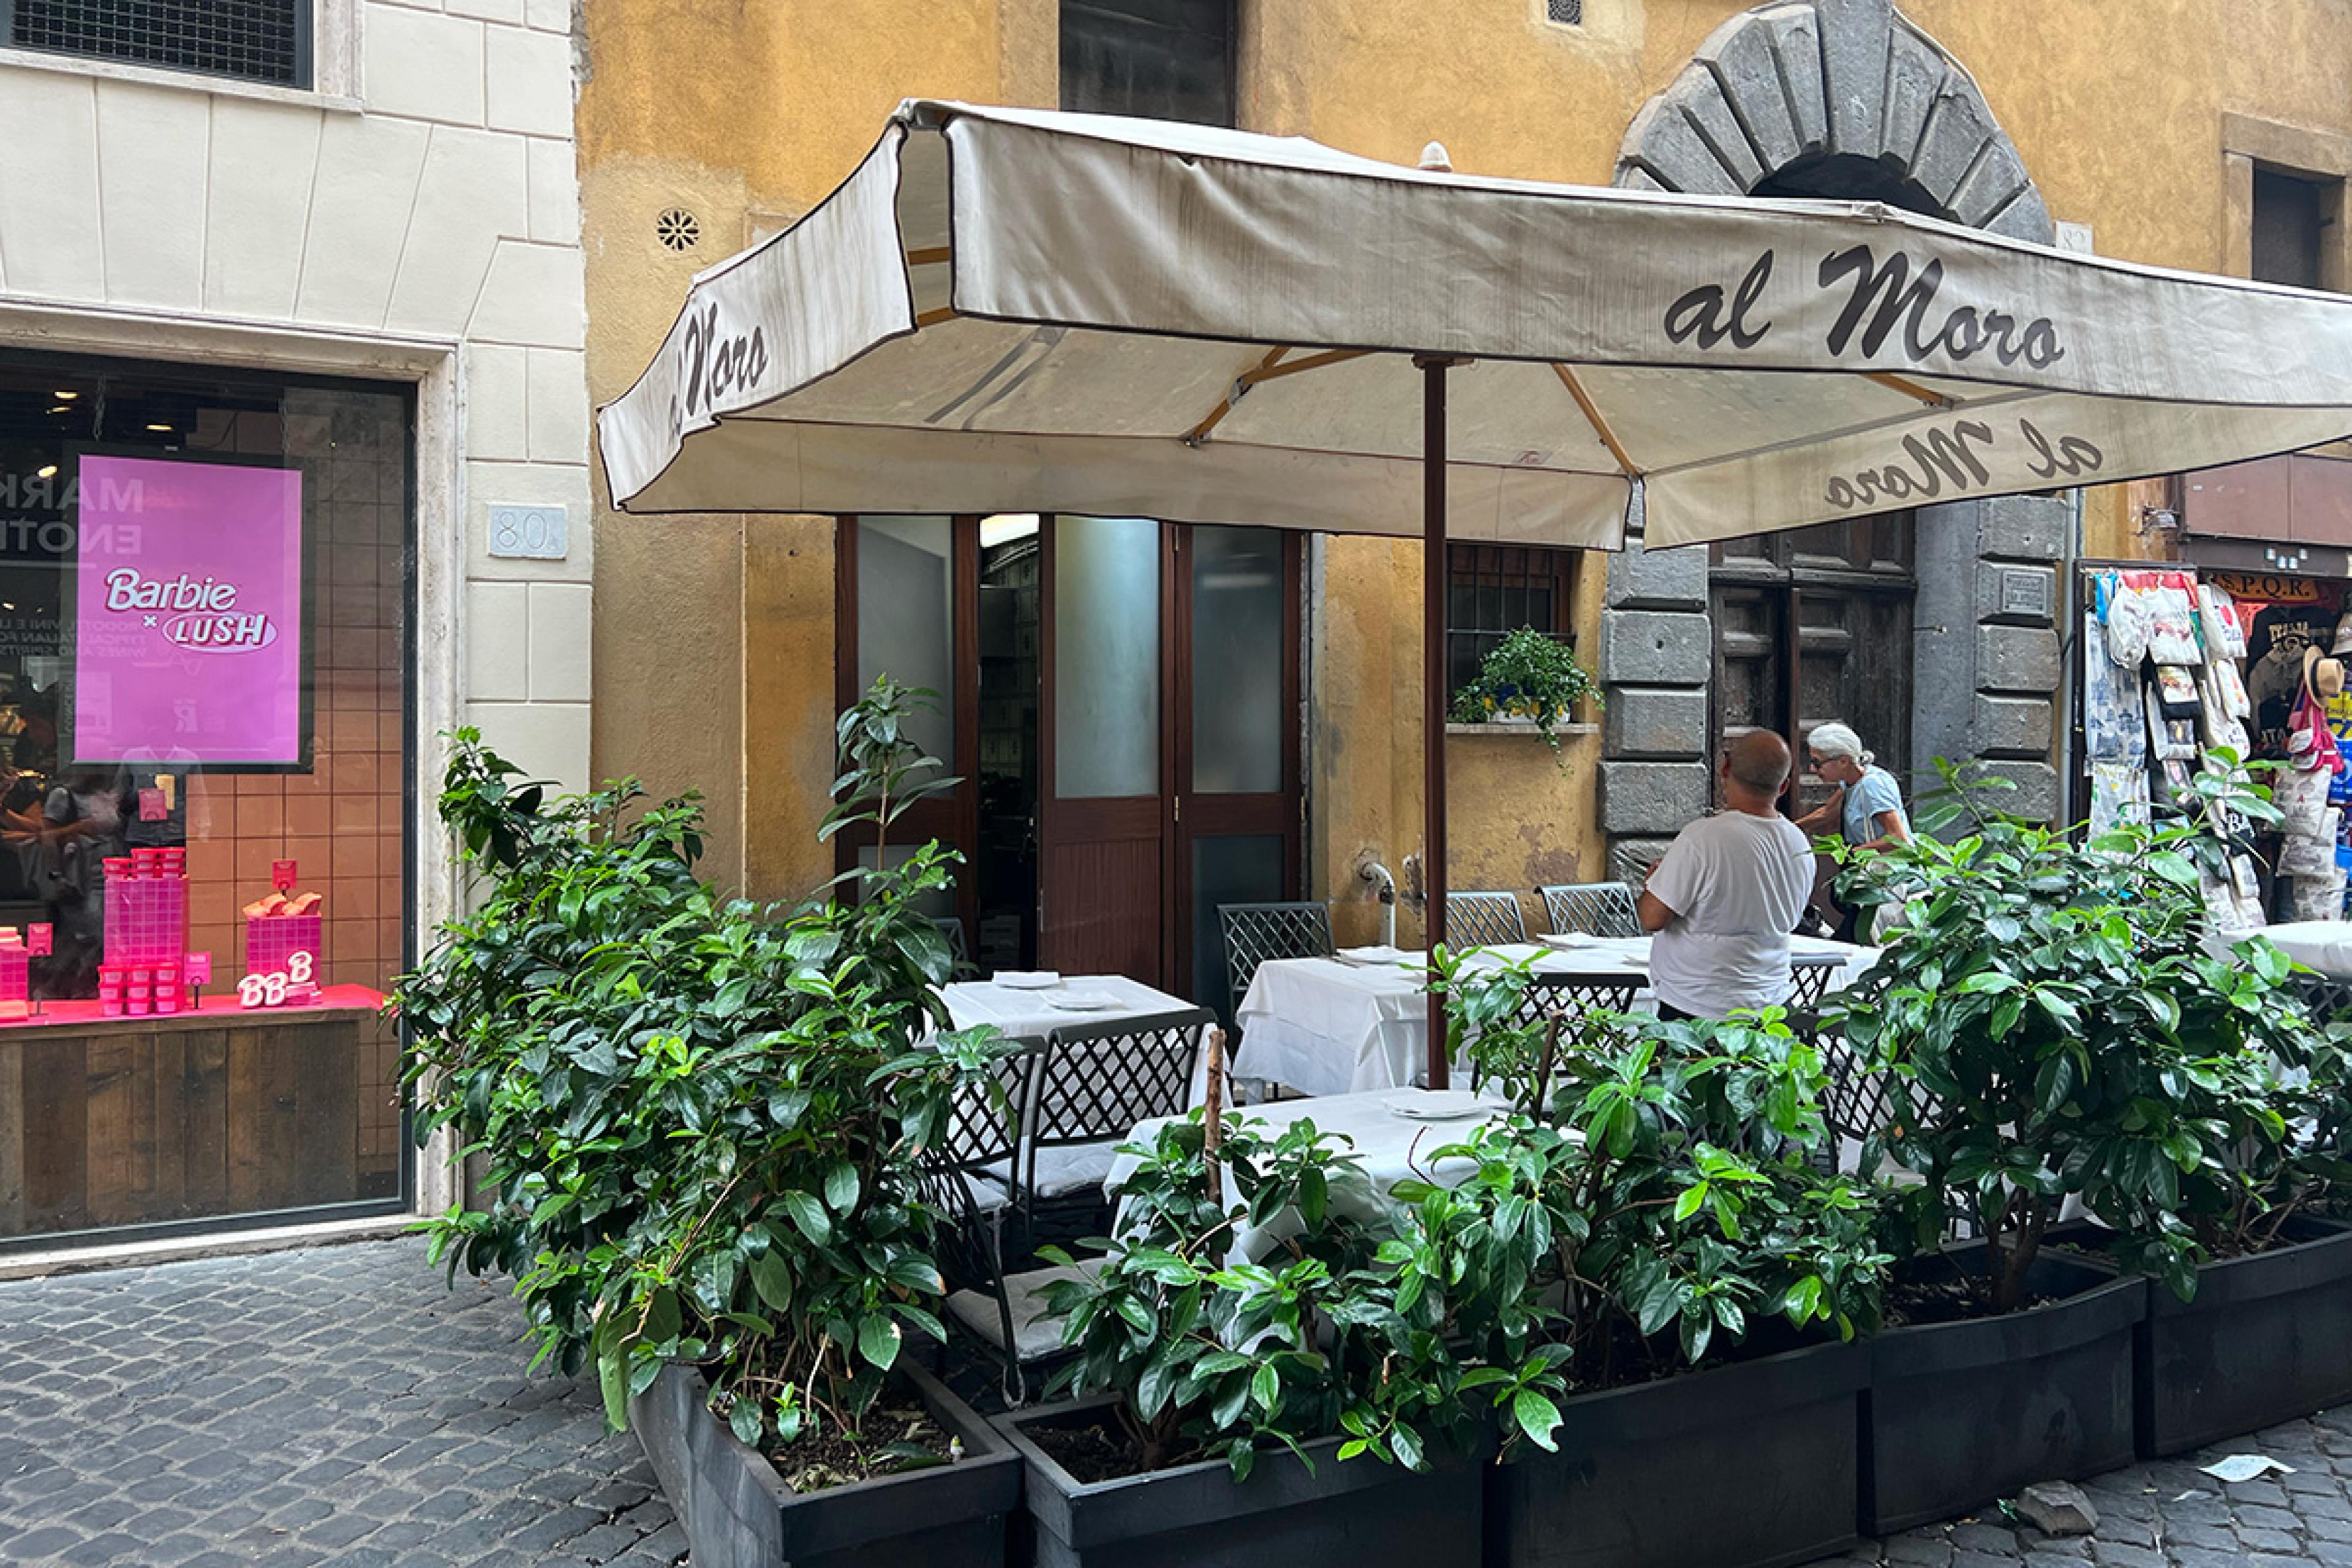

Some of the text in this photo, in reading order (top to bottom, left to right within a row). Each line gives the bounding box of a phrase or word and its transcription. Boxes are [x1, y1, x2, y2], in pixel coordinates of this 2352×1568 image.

[1664, 244, 2065, 369] al Moro
[684, 300, 769, 417] Moro
[105, 566, 237, 611] Barbie
[175, 612, 267, 645] LUSH
